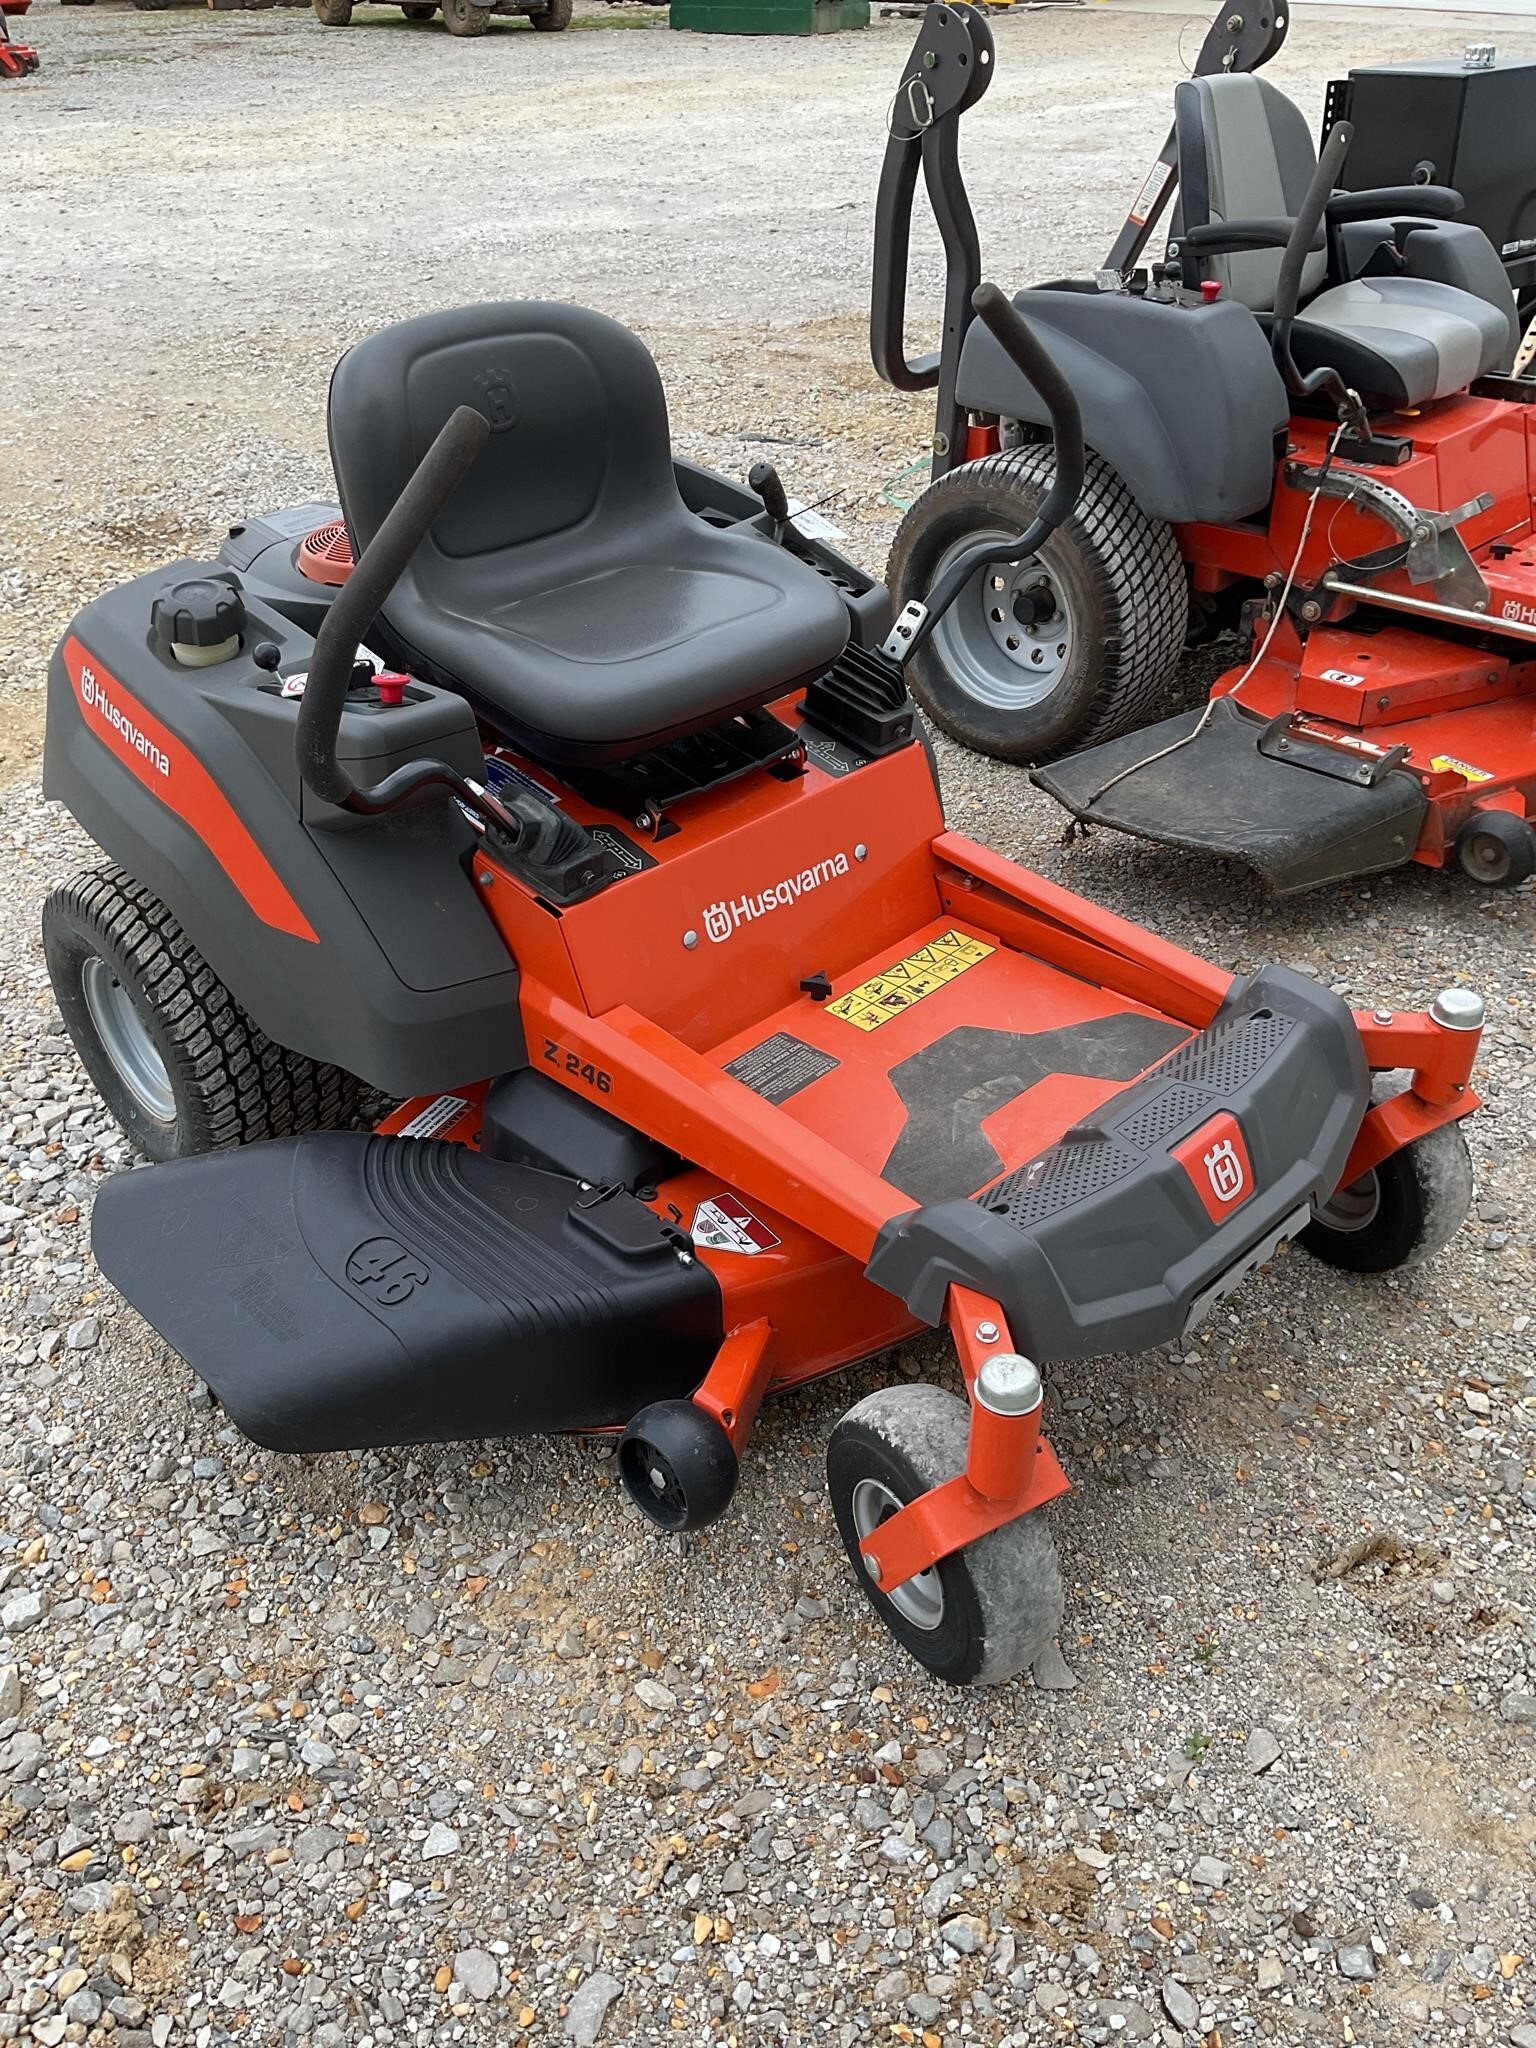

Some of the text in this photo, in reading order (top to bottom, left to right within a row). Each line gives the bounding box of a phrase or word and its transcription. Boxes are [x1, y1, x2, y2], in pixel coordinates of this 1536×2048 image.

[94, 683, 170, 777] Husqvarna
[729, 852, 850, 928] Husqvarna
[565, 1052, 612, 1094] 246
[430, 1108, 467, 1140] WARNIN
[350, 1251, 427, 1307] 46
